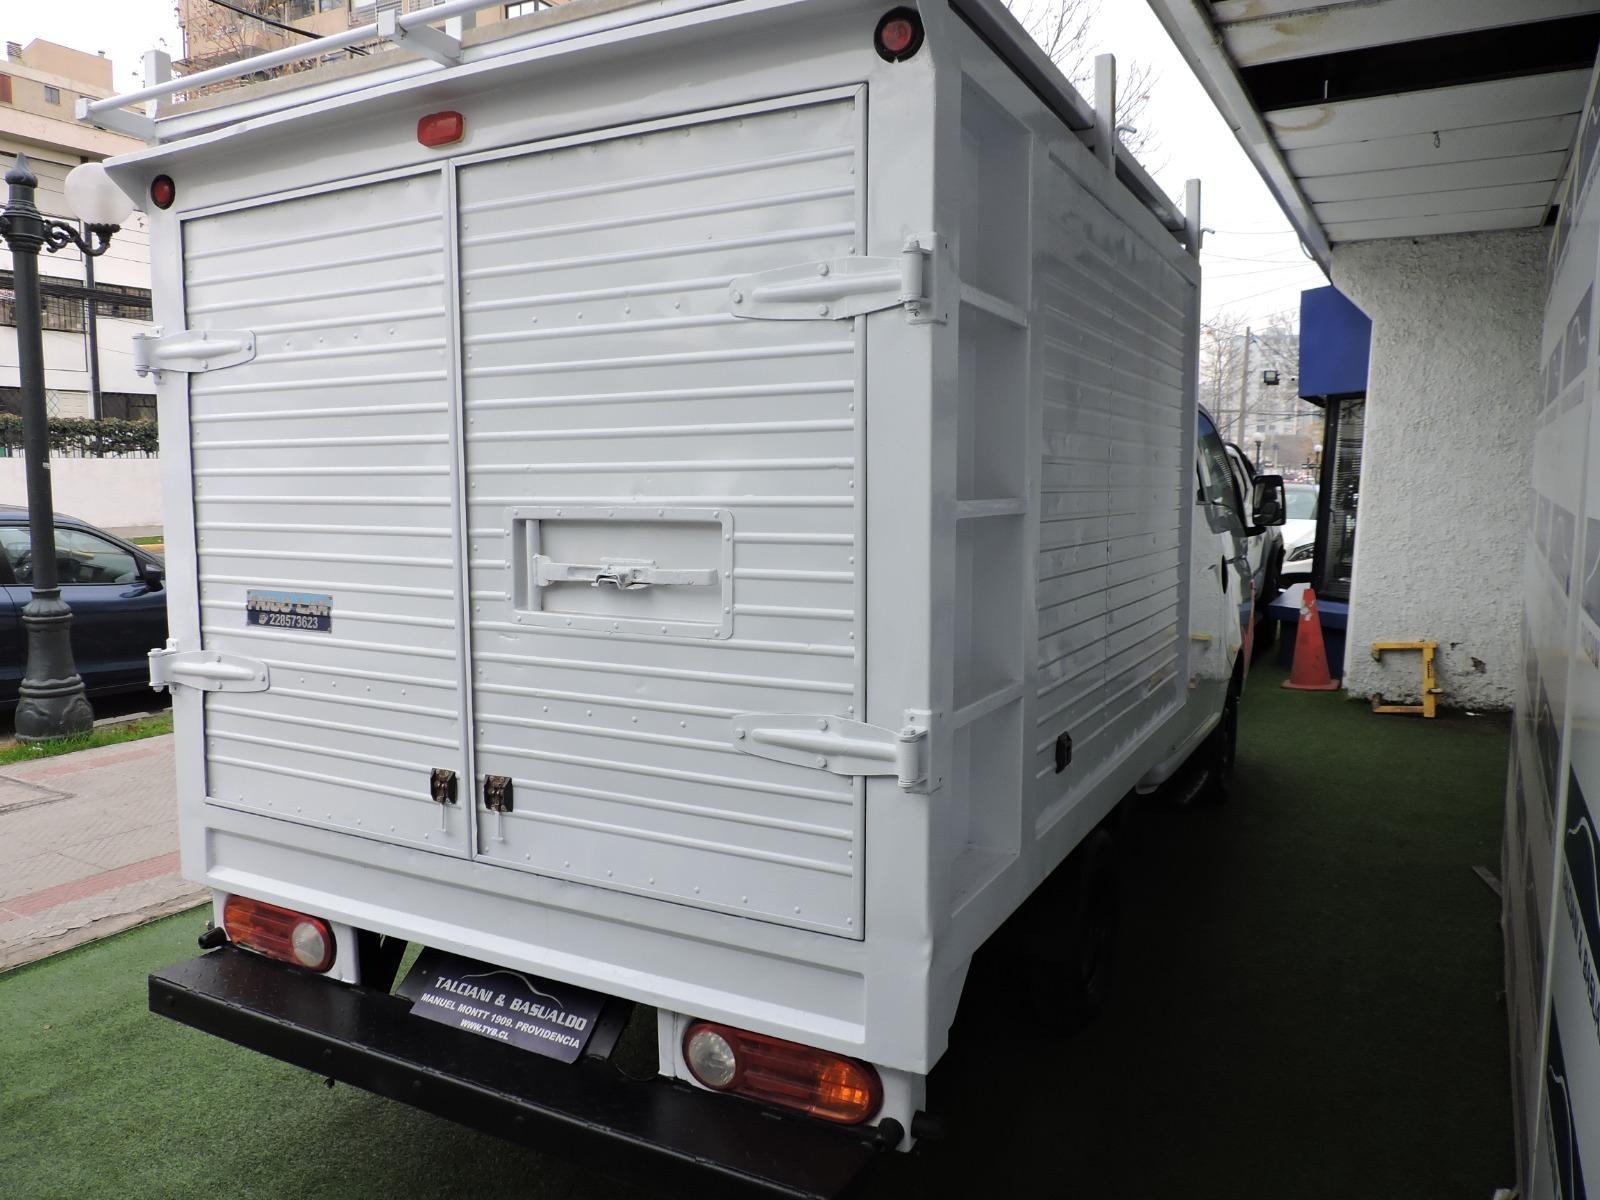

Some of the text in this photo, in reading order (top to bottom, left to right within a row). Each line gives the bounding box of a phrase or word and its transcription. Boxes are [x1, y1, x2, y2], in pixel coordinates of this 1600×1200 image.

[269, 613, 319, 629] 228573623
[420, 992, 581, 1049] MANUEL MONTT 1909. PROVIDENCIA
[434, 976, 588, 1032] TALCIANI & BASUALDO
[459, 1018, 510, 1041] WWW.TYB.CL
